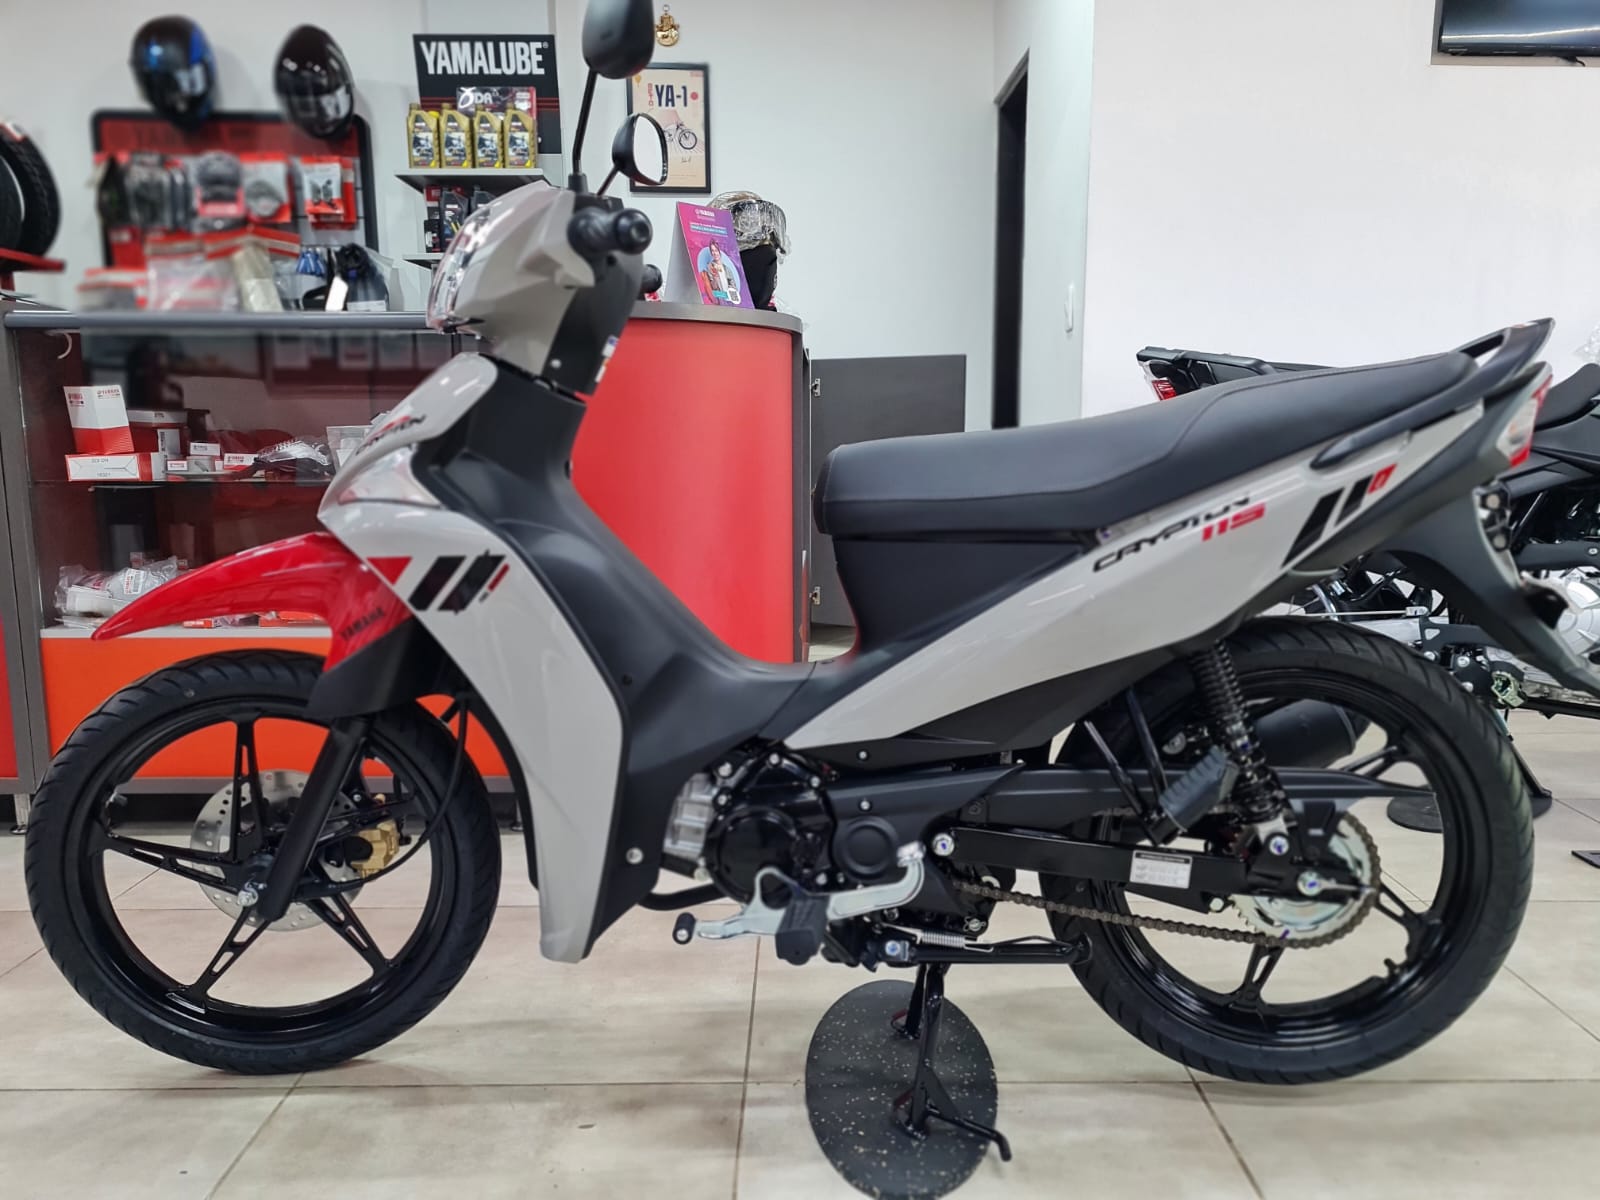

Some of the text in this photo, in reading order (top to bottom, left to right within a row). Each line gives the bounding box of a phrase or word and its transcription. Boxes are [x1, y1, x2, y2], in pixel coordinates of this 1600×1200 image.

[420, 41, 545, 75] YAMALUBE
[655, 84, 688, 107] YA-1
[1202, 503, 1266, 541] 115
